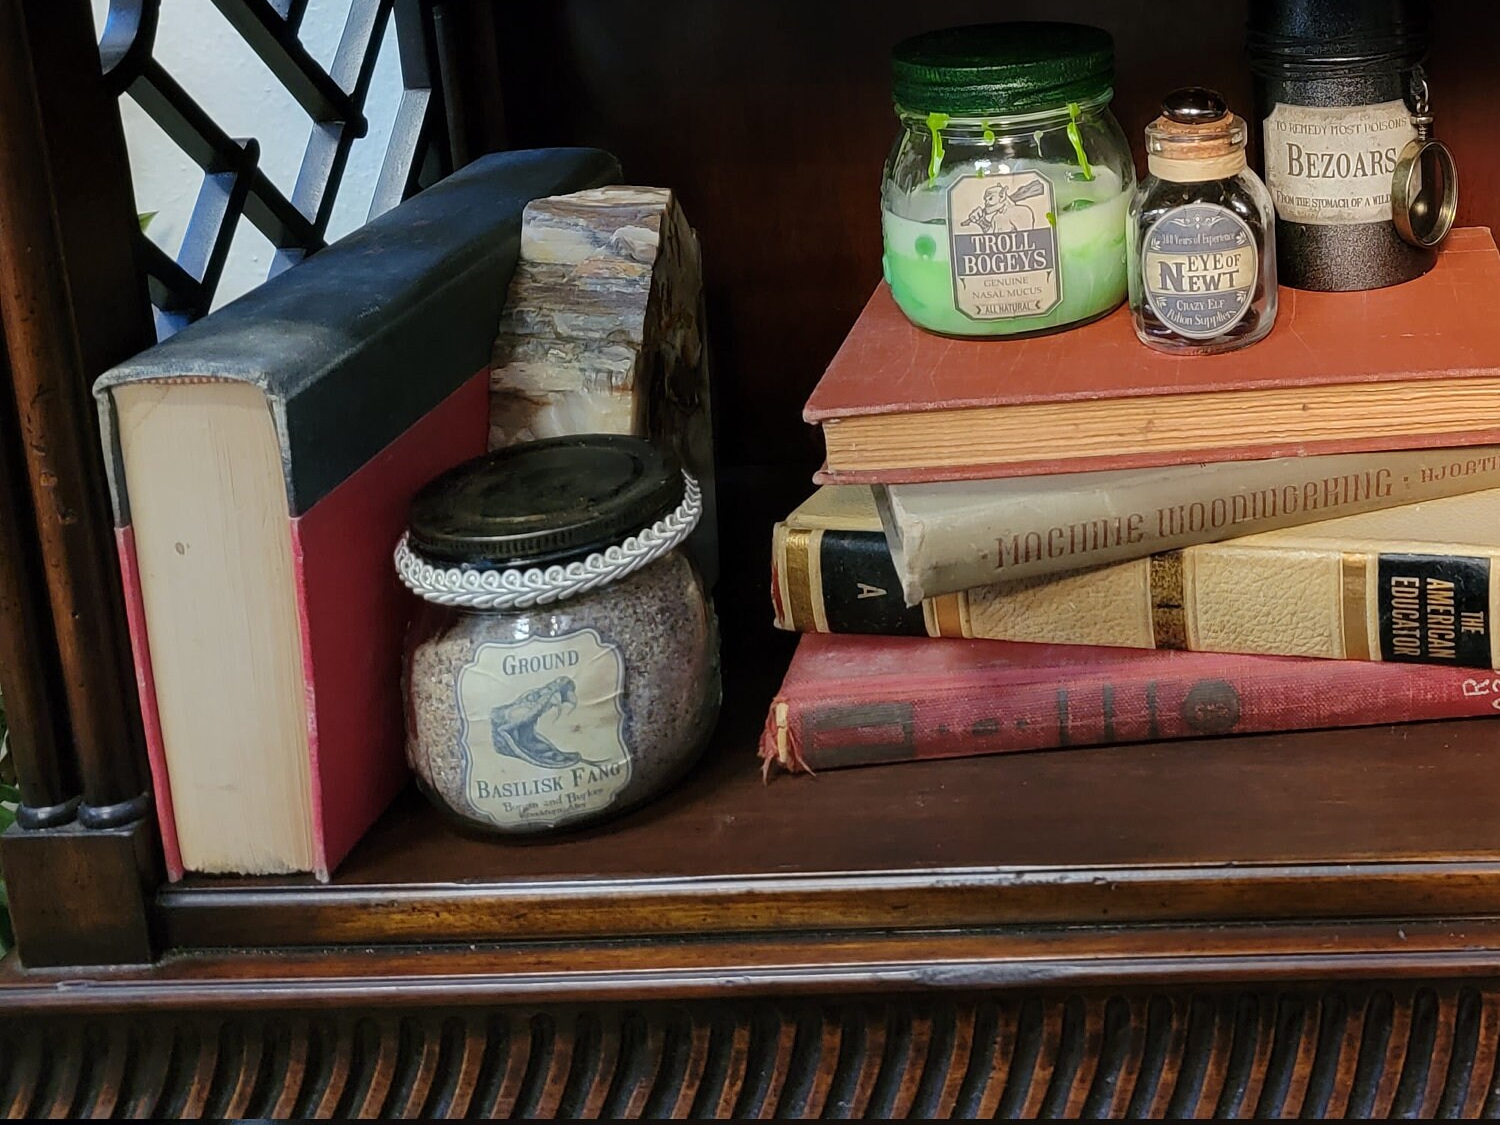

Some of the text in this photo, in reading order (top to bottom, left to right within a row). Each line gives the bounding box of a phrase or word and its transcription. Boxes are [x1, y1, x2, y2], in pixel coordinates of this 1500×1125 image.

[1289, 117, 1407, 135] REMEDY MOST POISONS
[1286, 143, 1397, 178] BEZOARS
[1311, 197, 1371, 208] STOMACH OF A
[971, 232, 1035, 254] TROLL
[963, 249, 1047, 275] BOGEYS
[1187, 253, 1241, 272] EYE OF
[984, 277, 1028, 287] GENUINE
[1158, 260, 1239, 292] NEWT
[972, 287, 1042, 299] NASAL MUCUS
[1176, 299, 1205, 311] CRAZY
[994, 512, 1145, 569] MACHINE
[1157, 467, 1394, 539] WOODWORKING
[856, 582, 888, 600] A
[1391, 577, 1420, 657] EDUCATOR
[1426, 577, 1456, 659] AMERICAN
[1460, 611, 1485, 635] THE
[502, 650, 579, 676] GROUND
[476, 762, 621, 799] BASILISK FANG
